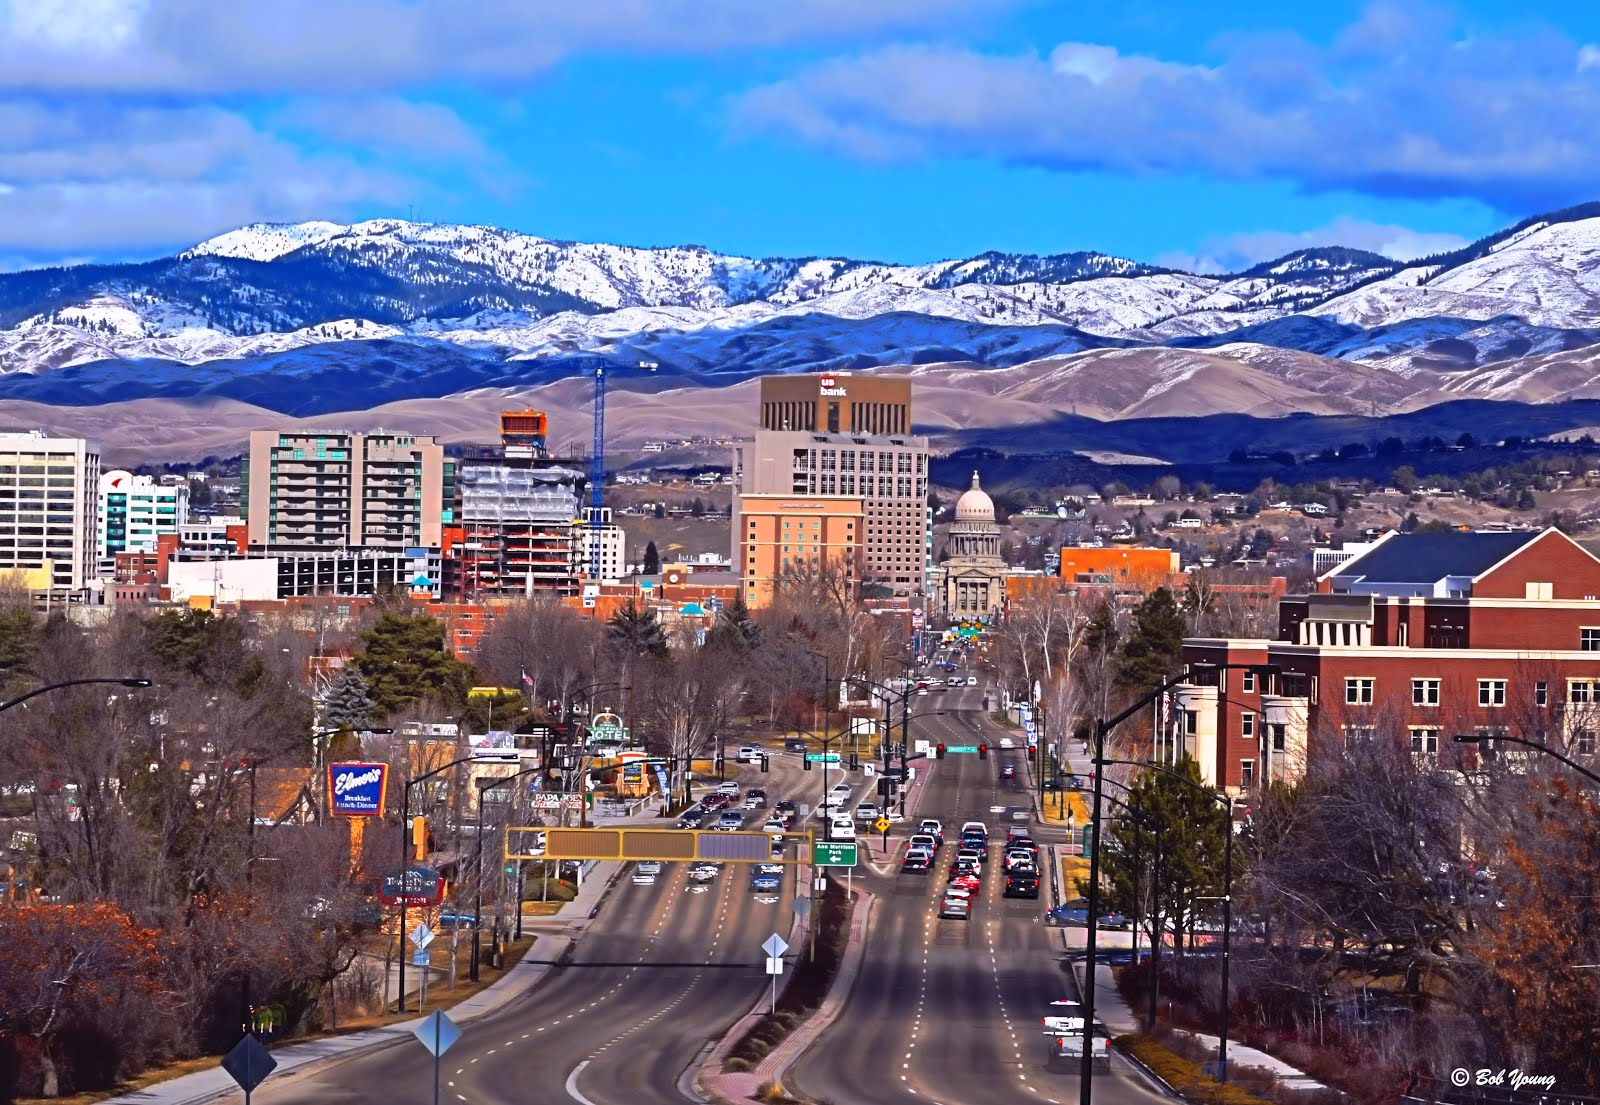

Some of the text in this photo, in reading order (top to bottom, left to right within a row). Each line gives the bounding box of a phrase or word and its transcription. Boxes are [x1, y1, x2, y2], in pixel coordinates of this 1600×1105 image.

[821, 378, 835, 386] us
[820, 386, 847, 397] bank
[334, 769, 382, 795] Elmer's
[344, 794, 372, 802] Breakfast
[535, 793, 559, 801] PAPA
